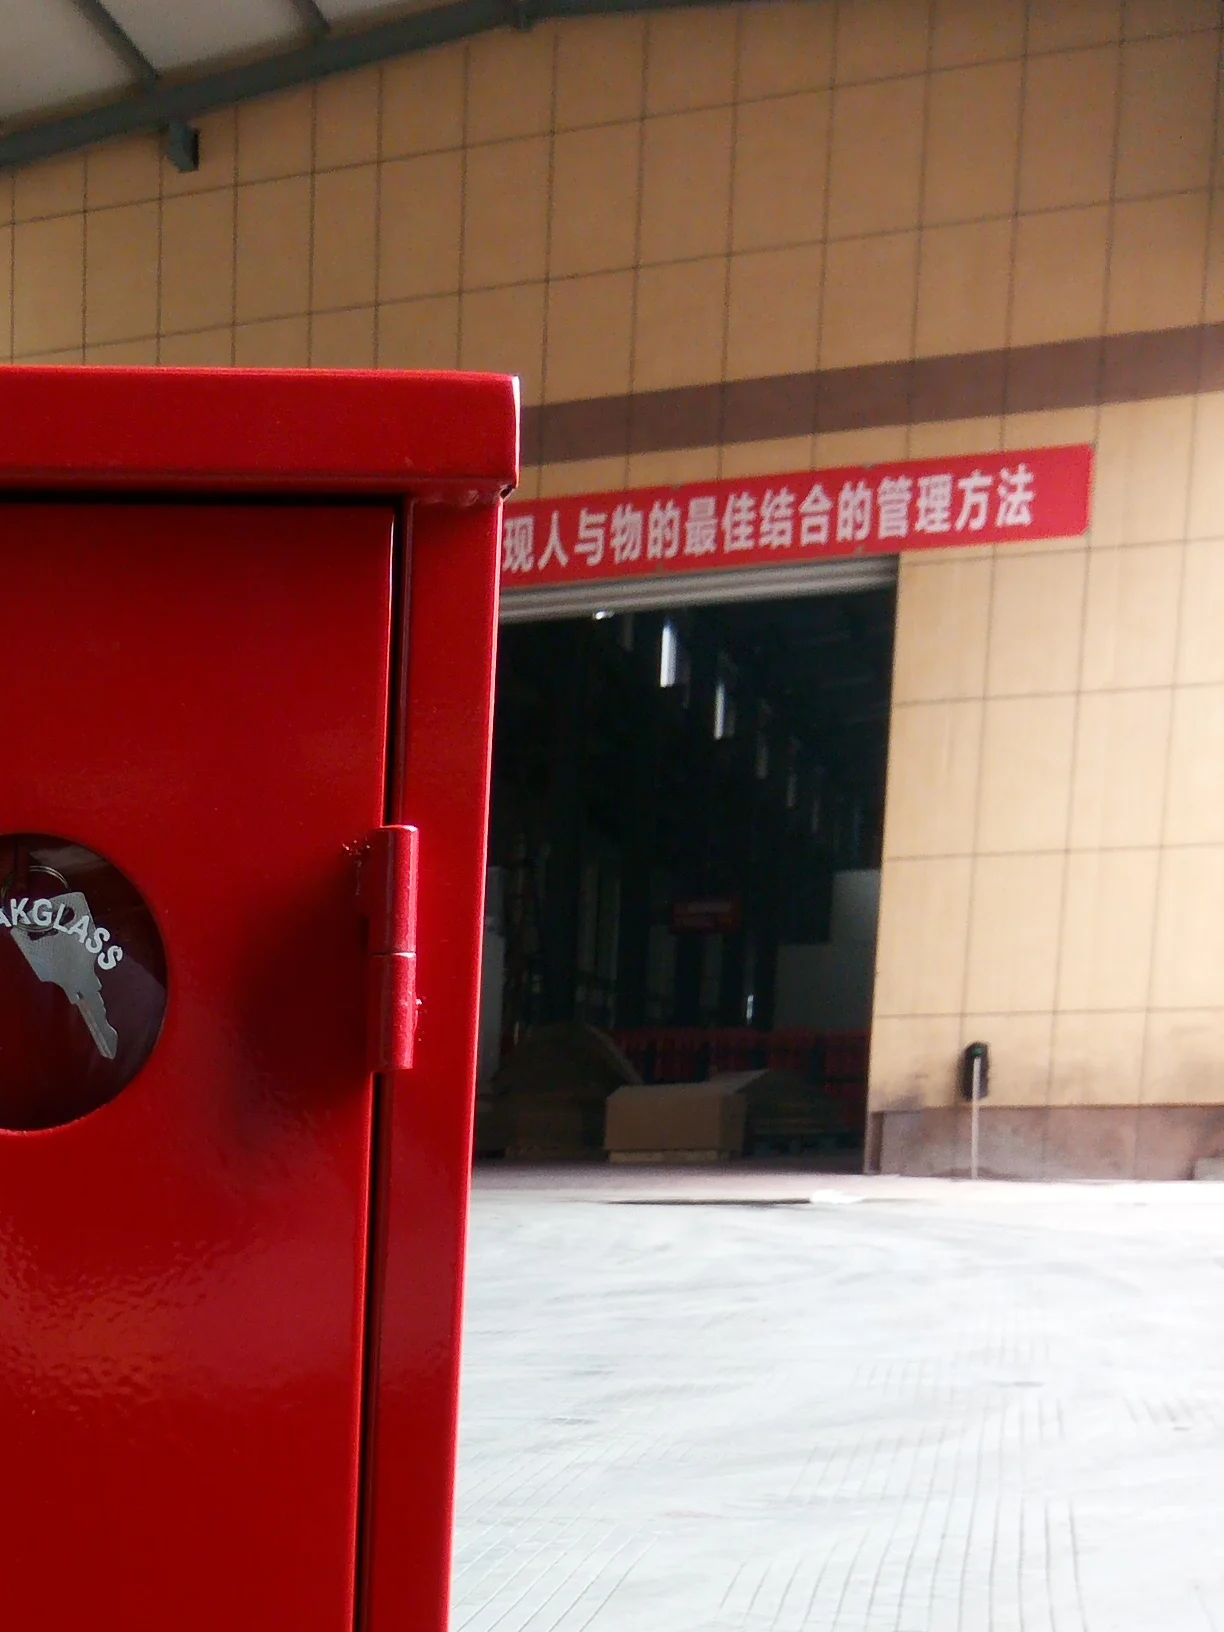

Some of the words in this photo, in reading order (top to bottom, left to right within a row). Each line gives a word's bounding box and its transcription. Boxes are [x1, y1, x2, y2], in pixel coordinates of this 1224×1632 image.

[502, 464, 1034, 573] 现人与物的最佳结合的管理方法
